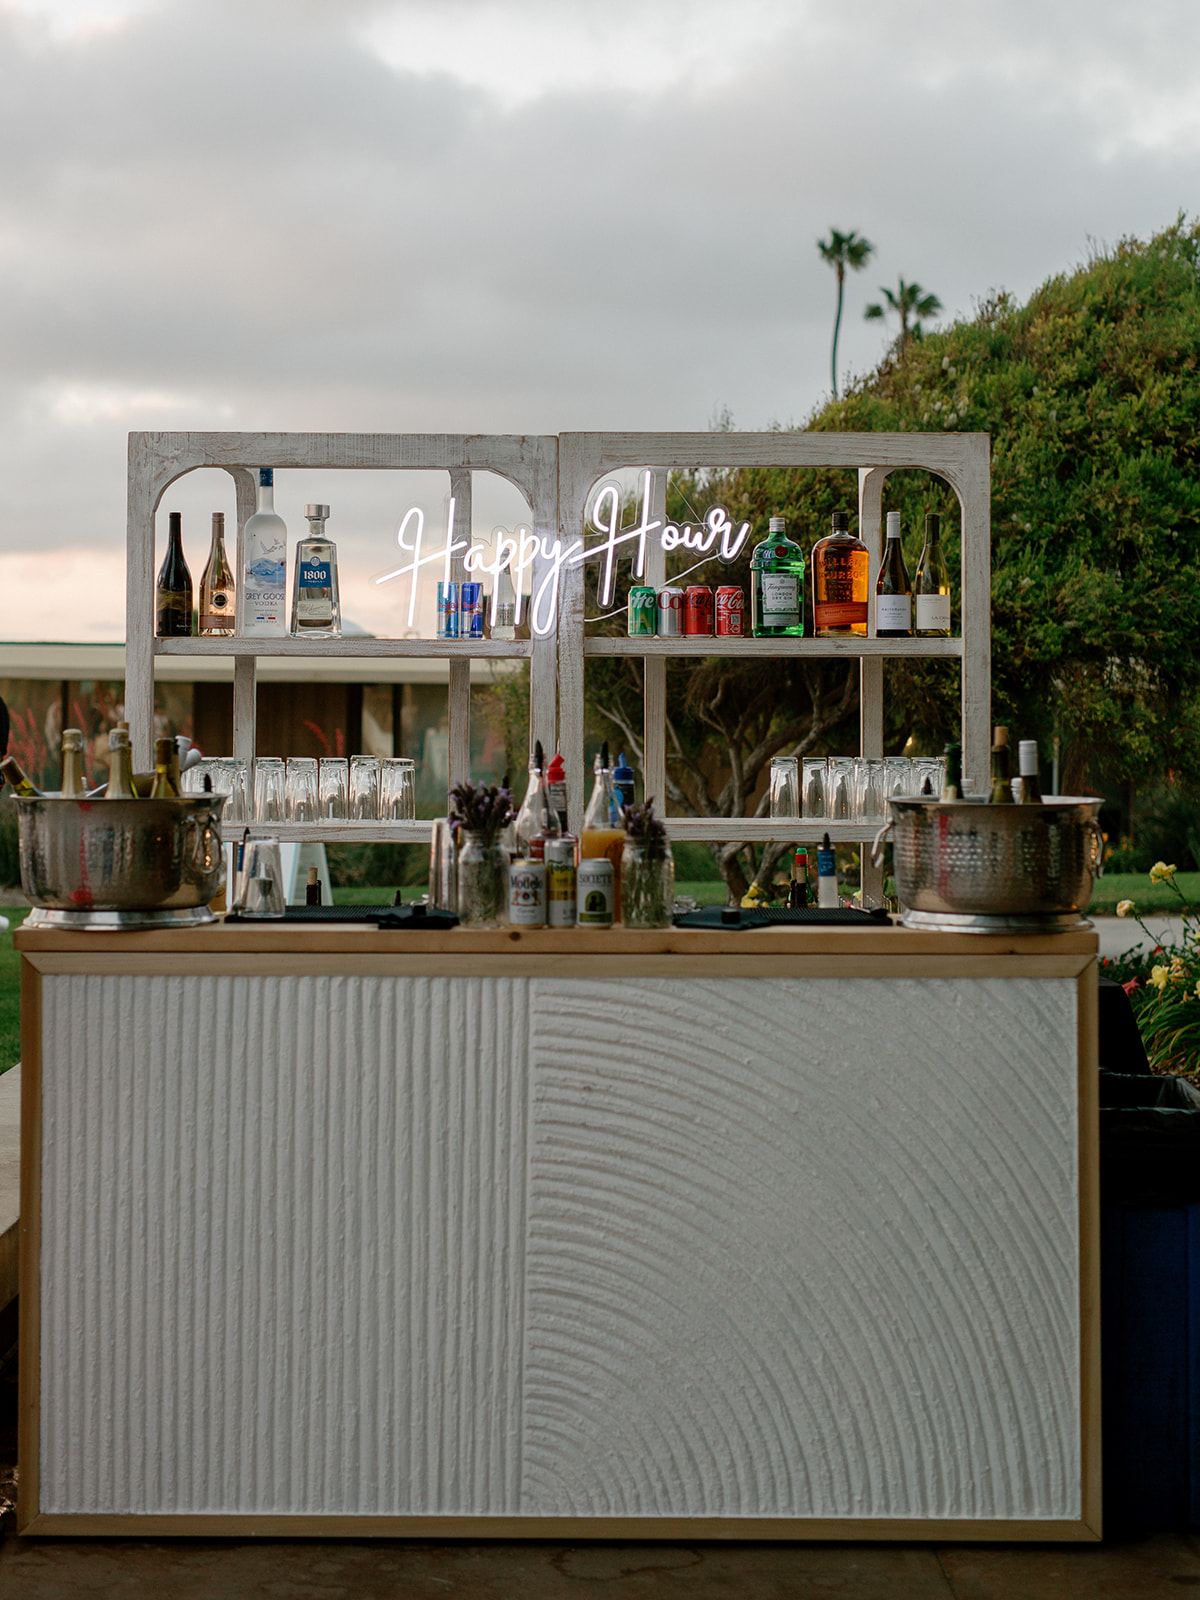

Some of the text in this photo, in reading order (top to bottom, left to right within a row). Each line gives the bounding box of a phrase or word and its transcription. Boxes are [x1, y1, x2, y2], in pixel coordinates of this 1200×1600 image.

[376, 470, 750, 635] Happy Hour
[303, 570, 327, 580] 1800
[510, 874, 543, 890] Modelo
